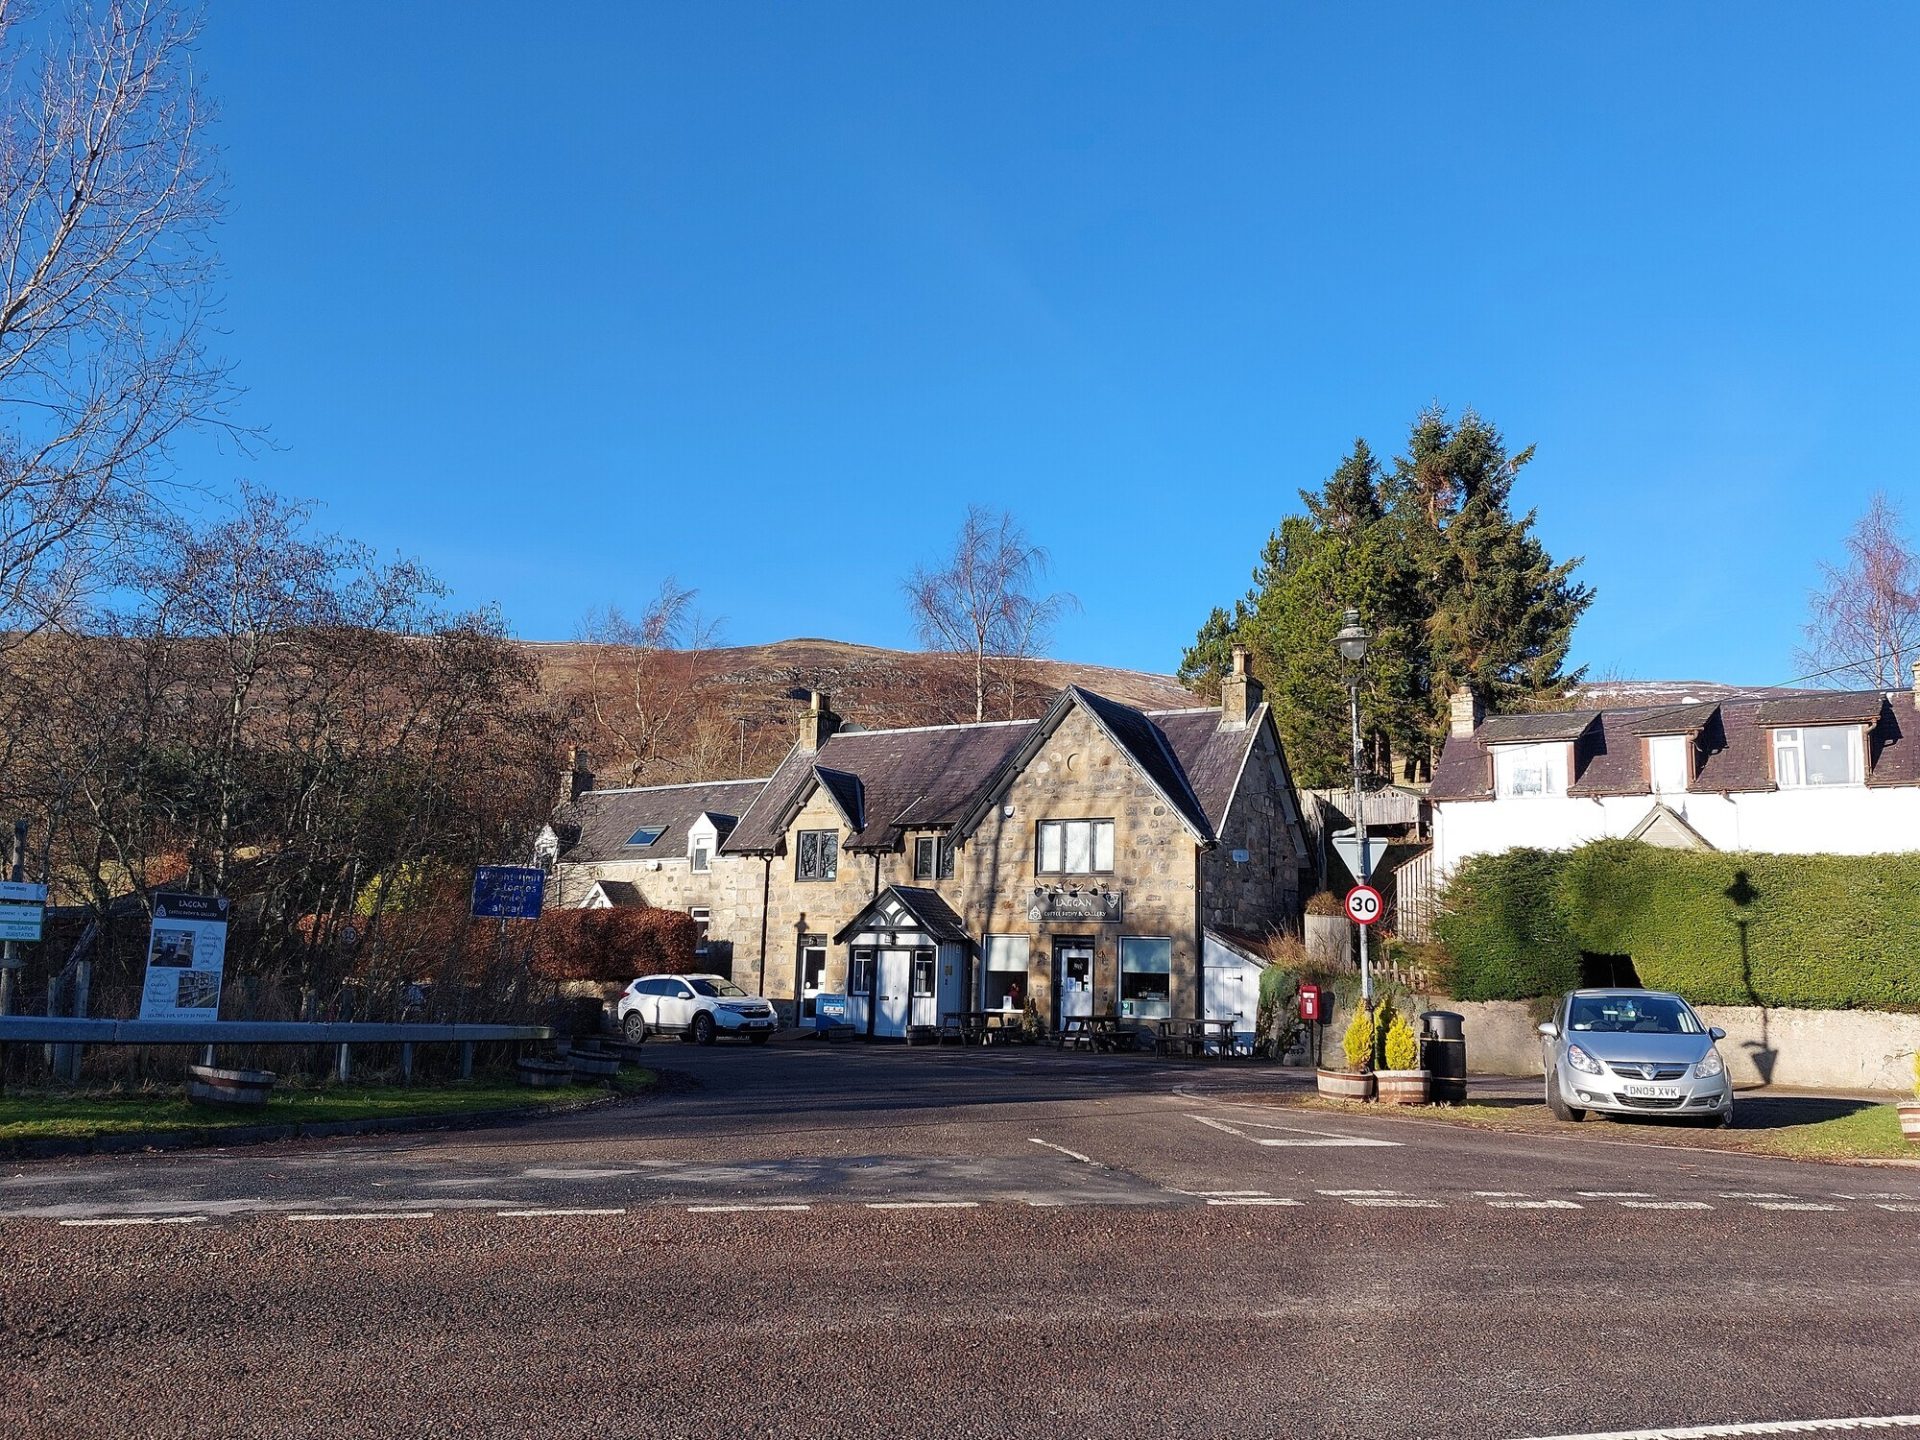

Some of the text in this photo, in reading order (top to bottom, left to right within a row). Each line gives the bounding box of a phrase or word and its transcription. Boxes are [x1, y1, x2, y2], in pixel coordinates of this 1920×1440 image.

[480, 871, 541, 883] Weight limit
[1055, 898, 1092, 907] LAGGAN
[1352, 897, 1376, 913] 30
[492, 903, 524, 913] ahead
[1629, 1086, 1677, 1096] DN09 XVK
